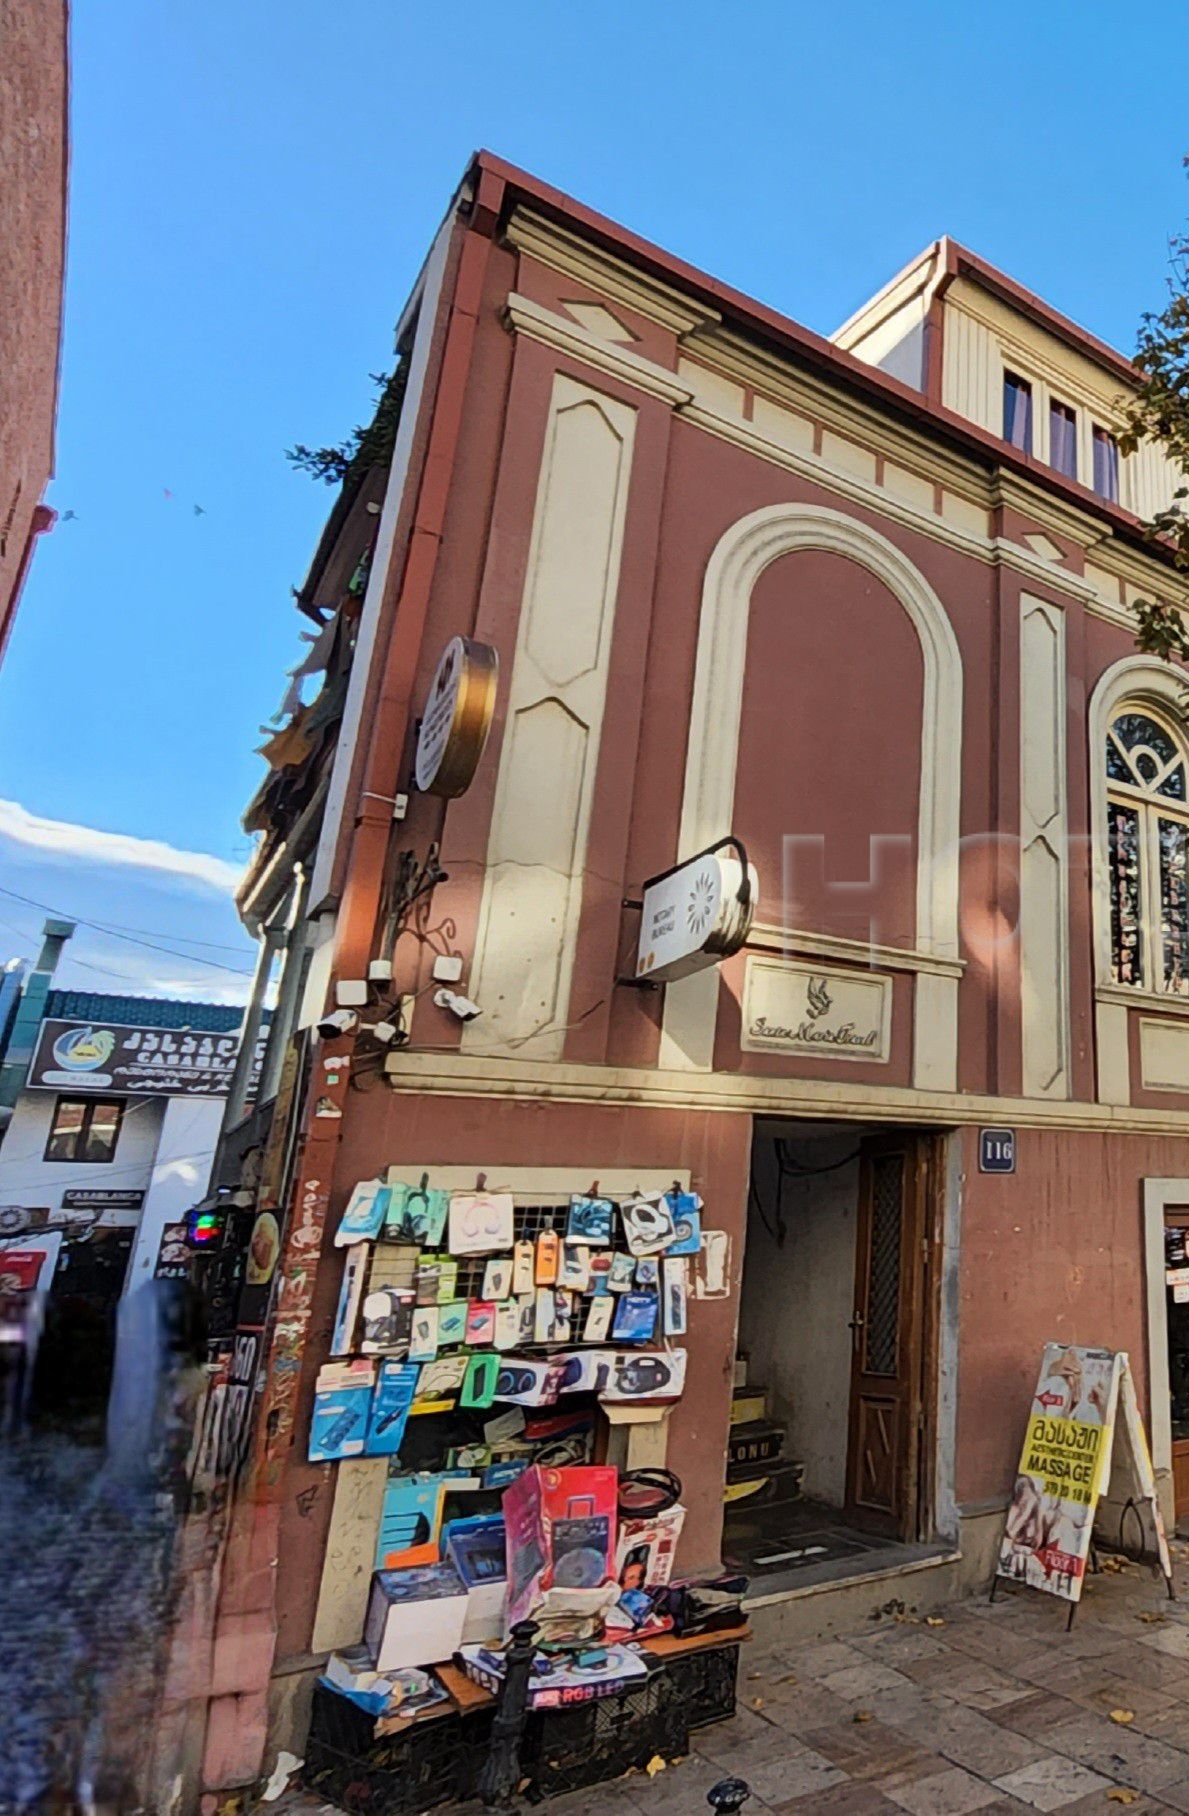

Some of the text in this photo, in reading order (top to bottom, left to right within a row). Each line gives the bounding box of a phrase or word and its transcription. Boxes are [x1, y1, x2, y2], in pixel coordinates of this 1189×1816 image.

[987, 1141, 1012, 1160] 116
[1027, 1454, 1092, 1484] MASSAGE
[562, 1686, 595, 1704] RGB
